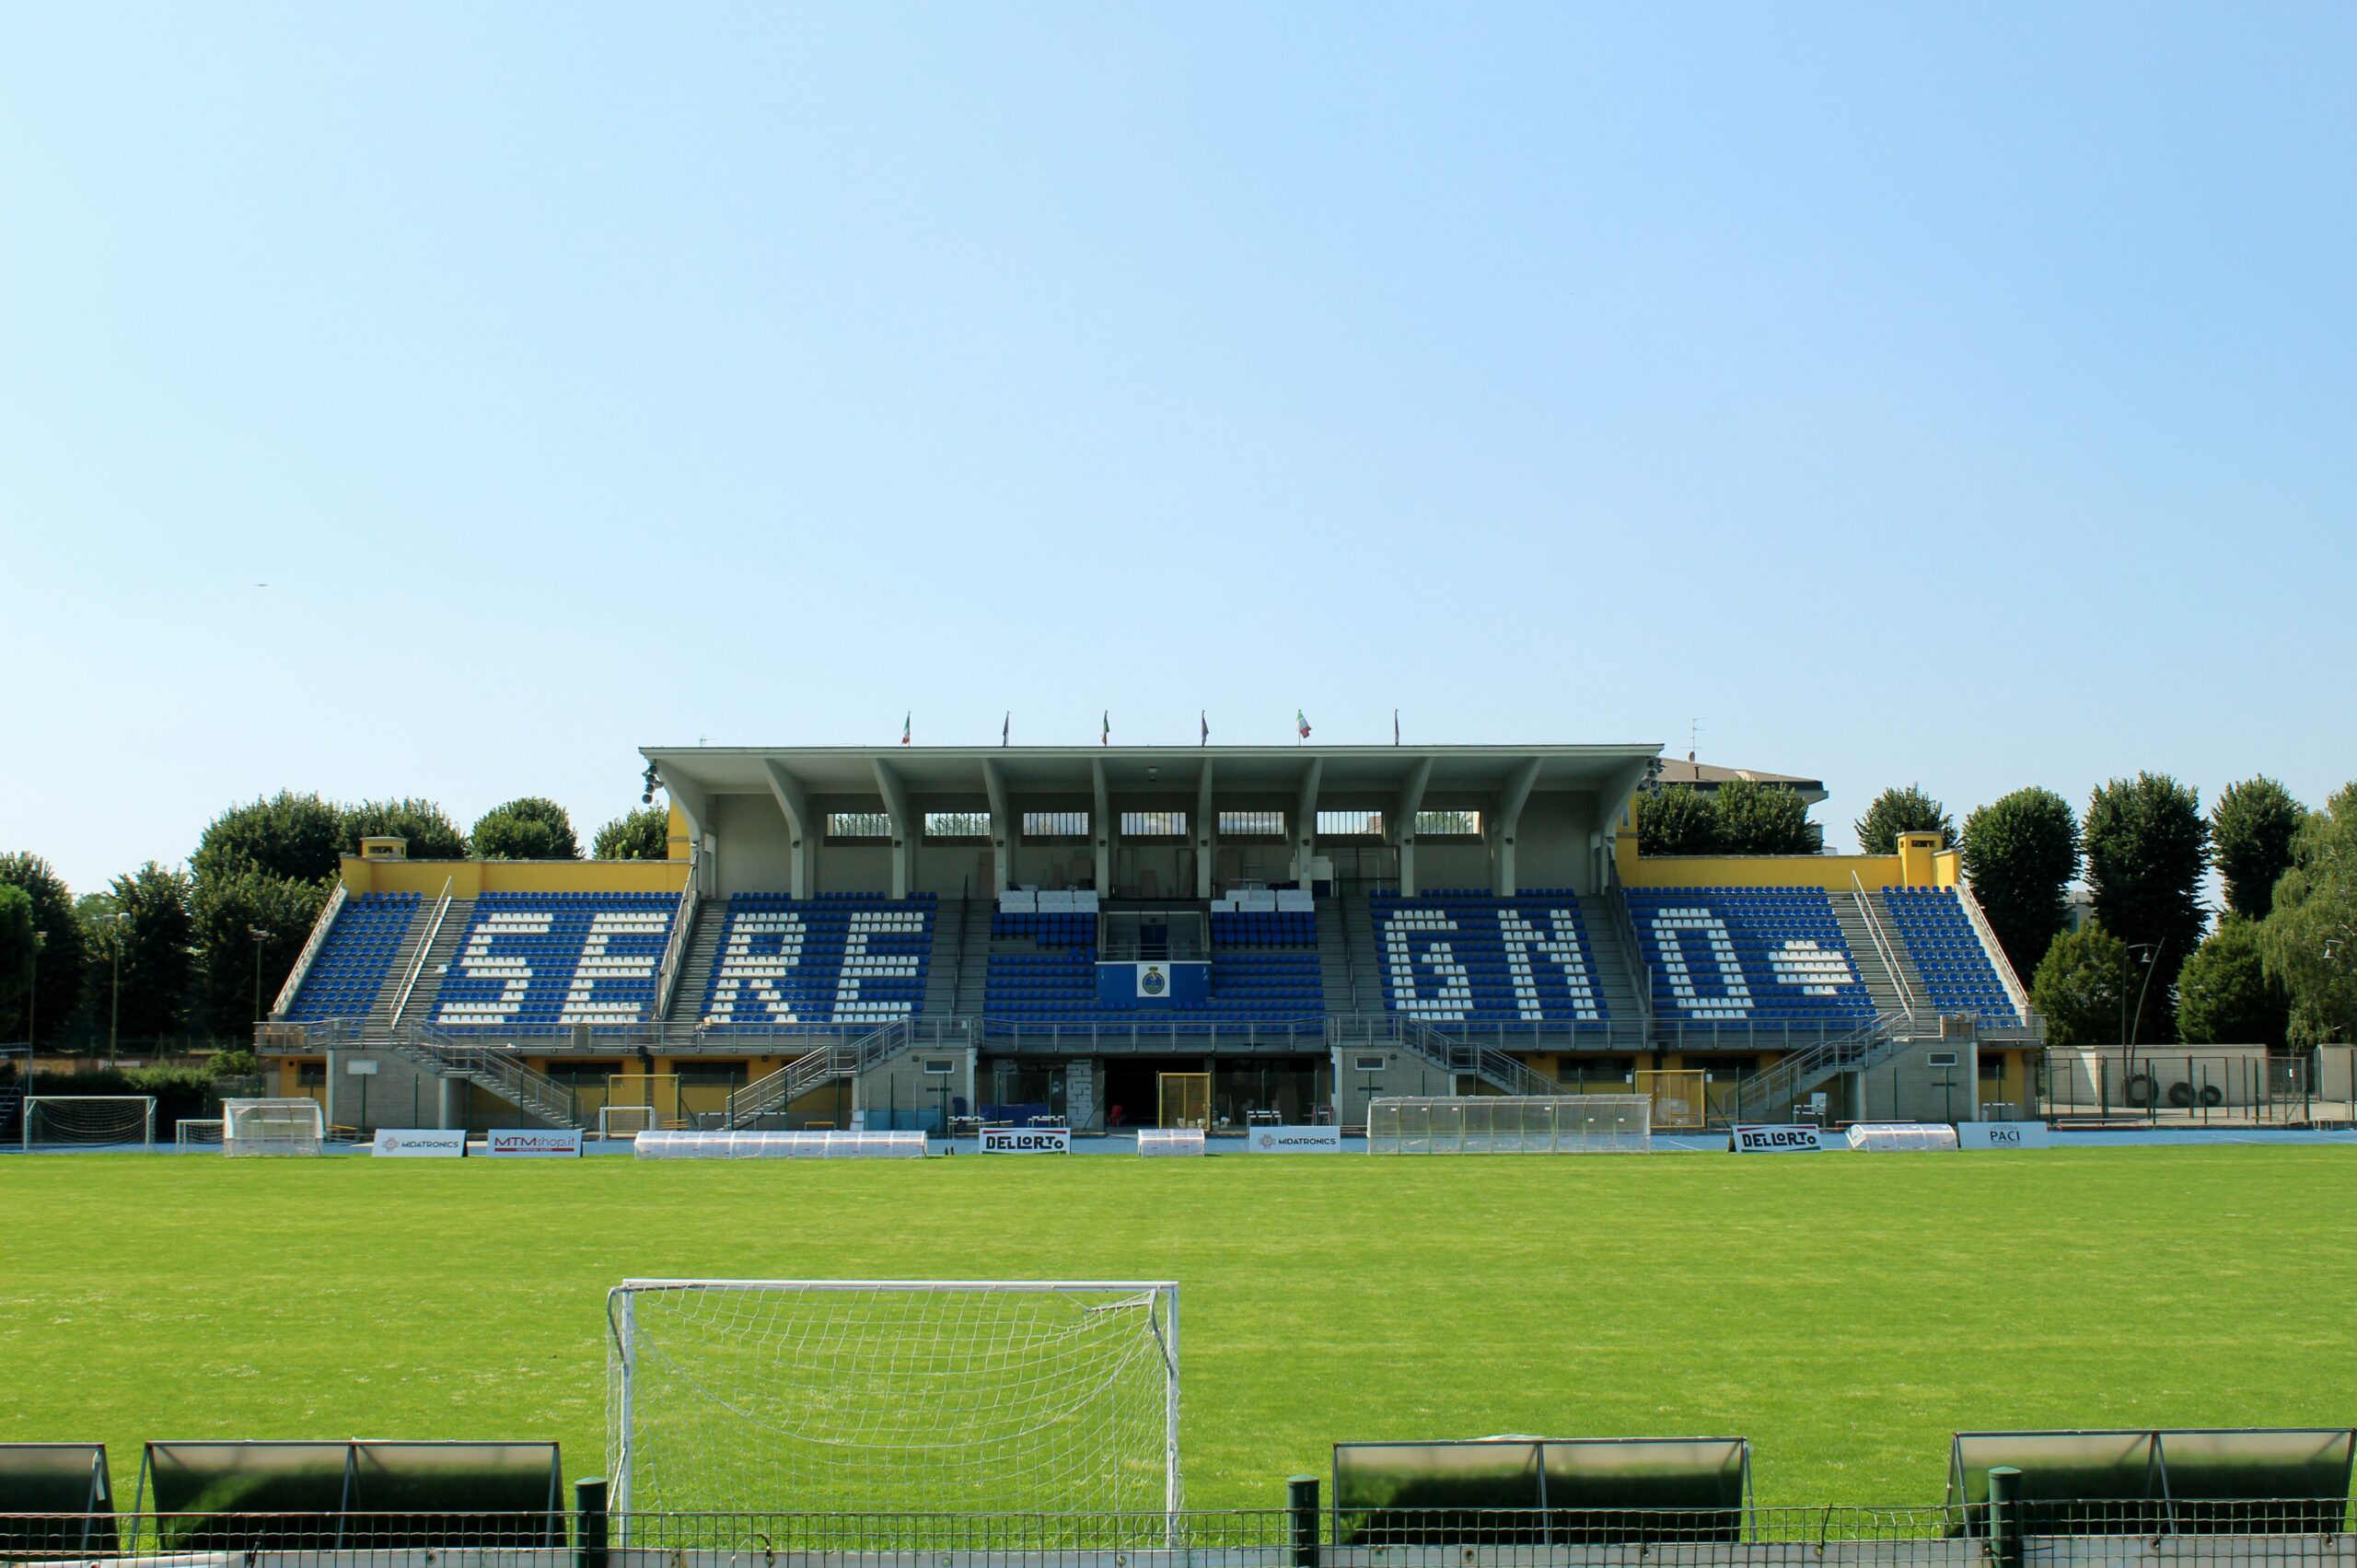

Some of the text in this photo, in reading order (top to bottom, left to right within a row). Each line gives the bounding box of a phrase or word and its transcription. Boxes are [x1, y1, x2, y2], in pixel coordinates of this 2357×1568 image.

[1278, 1137, 1337, 1145] MIDATRONICS
[1990, 1131, 2020, 1141] PACI
[494, 1136, 575, 1148] MTMshop.it
